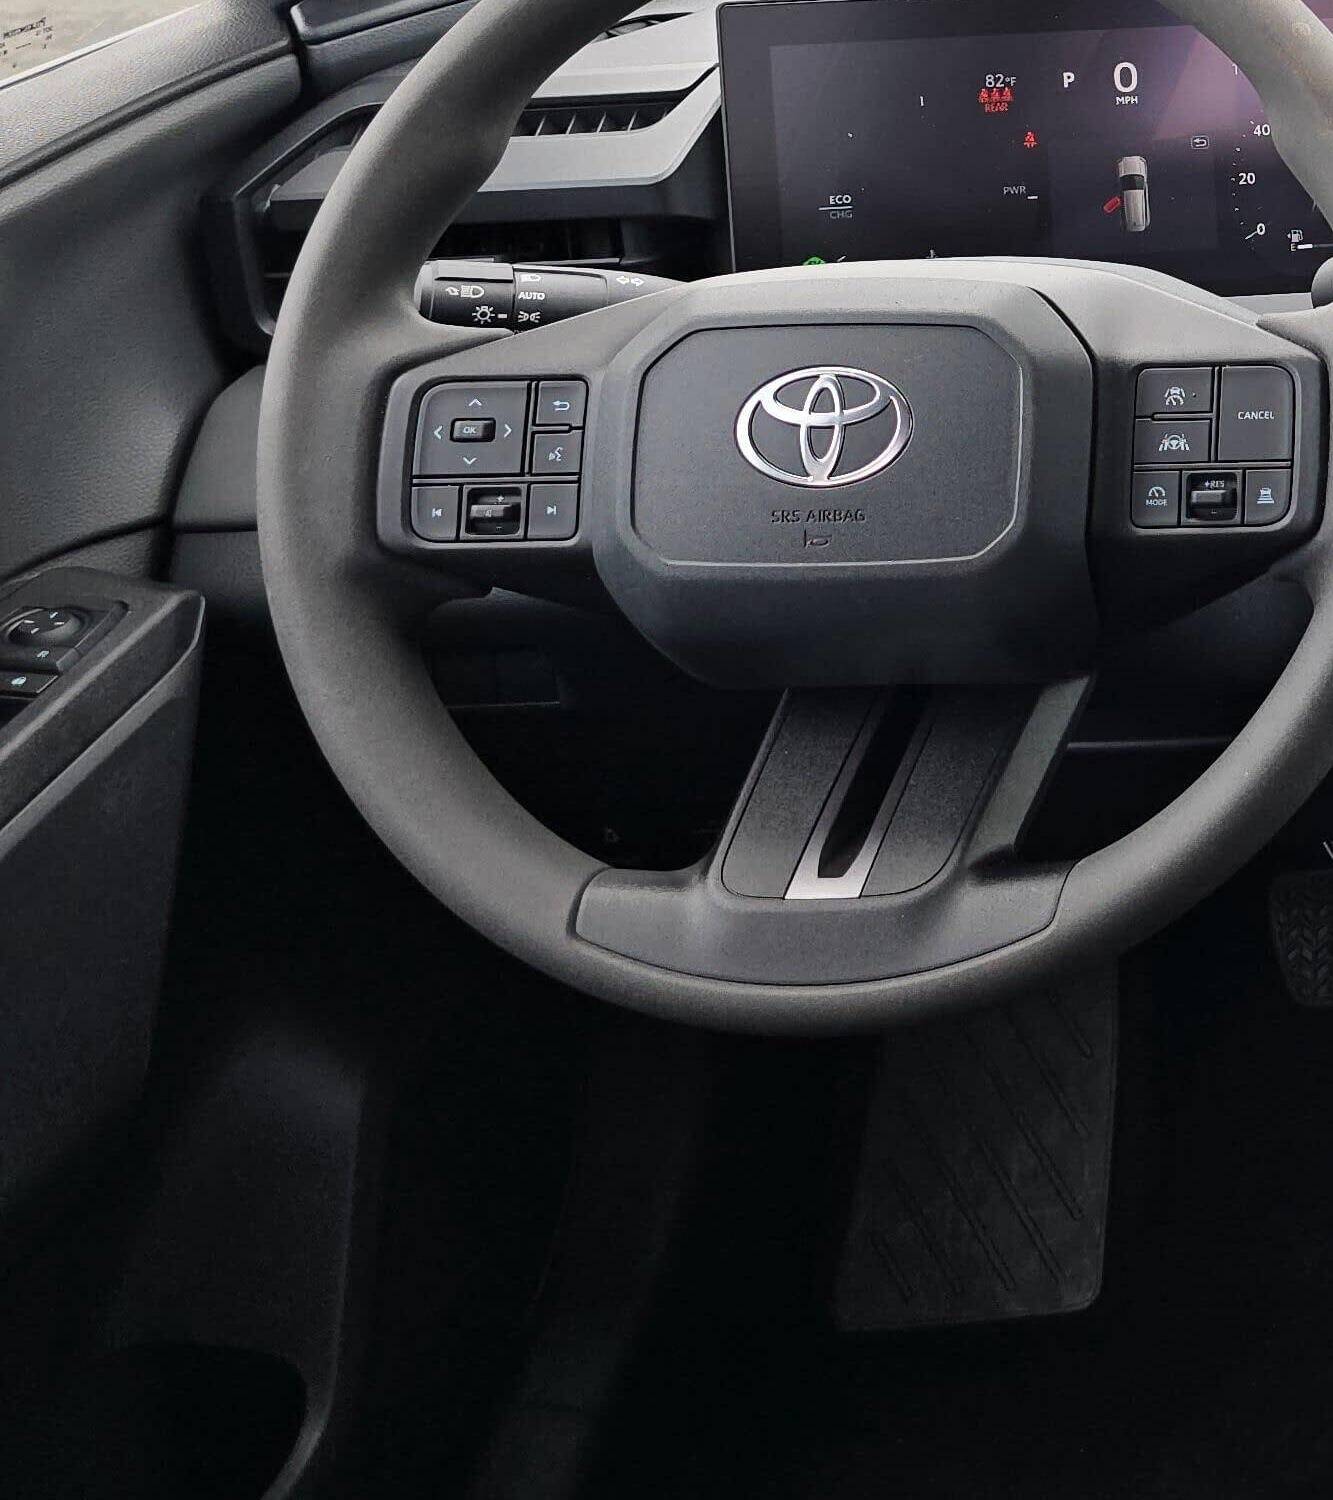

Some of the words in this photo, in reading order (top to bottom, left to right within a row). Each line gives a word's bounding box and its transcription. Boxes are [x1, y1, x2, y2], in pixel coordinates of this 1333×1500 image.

[1062, 72, 1075, 88] P
[1116, 96, 1139, 105] MPH
[985, 103, 1008, 113] REAR
[1253, 124, 1271, 136] 40
[1238, 173, 1256, 185] 20
[1003, 186, 1027, 195] PWR
[829, 194, 852, 205] ECO
[829, 210, 853, 219] CHG
[1256, 223, 1266, 236] 0
[518, 291, 546, 301] AUTO
[1237, 411, 1275, 420] CANCEL
[462, 426, 477, 435] OK
[1145, 498, 1168, 507] MODE
[770, 509, 801, 524] SRS
[805, 508, 867, 524] AIRBAG
